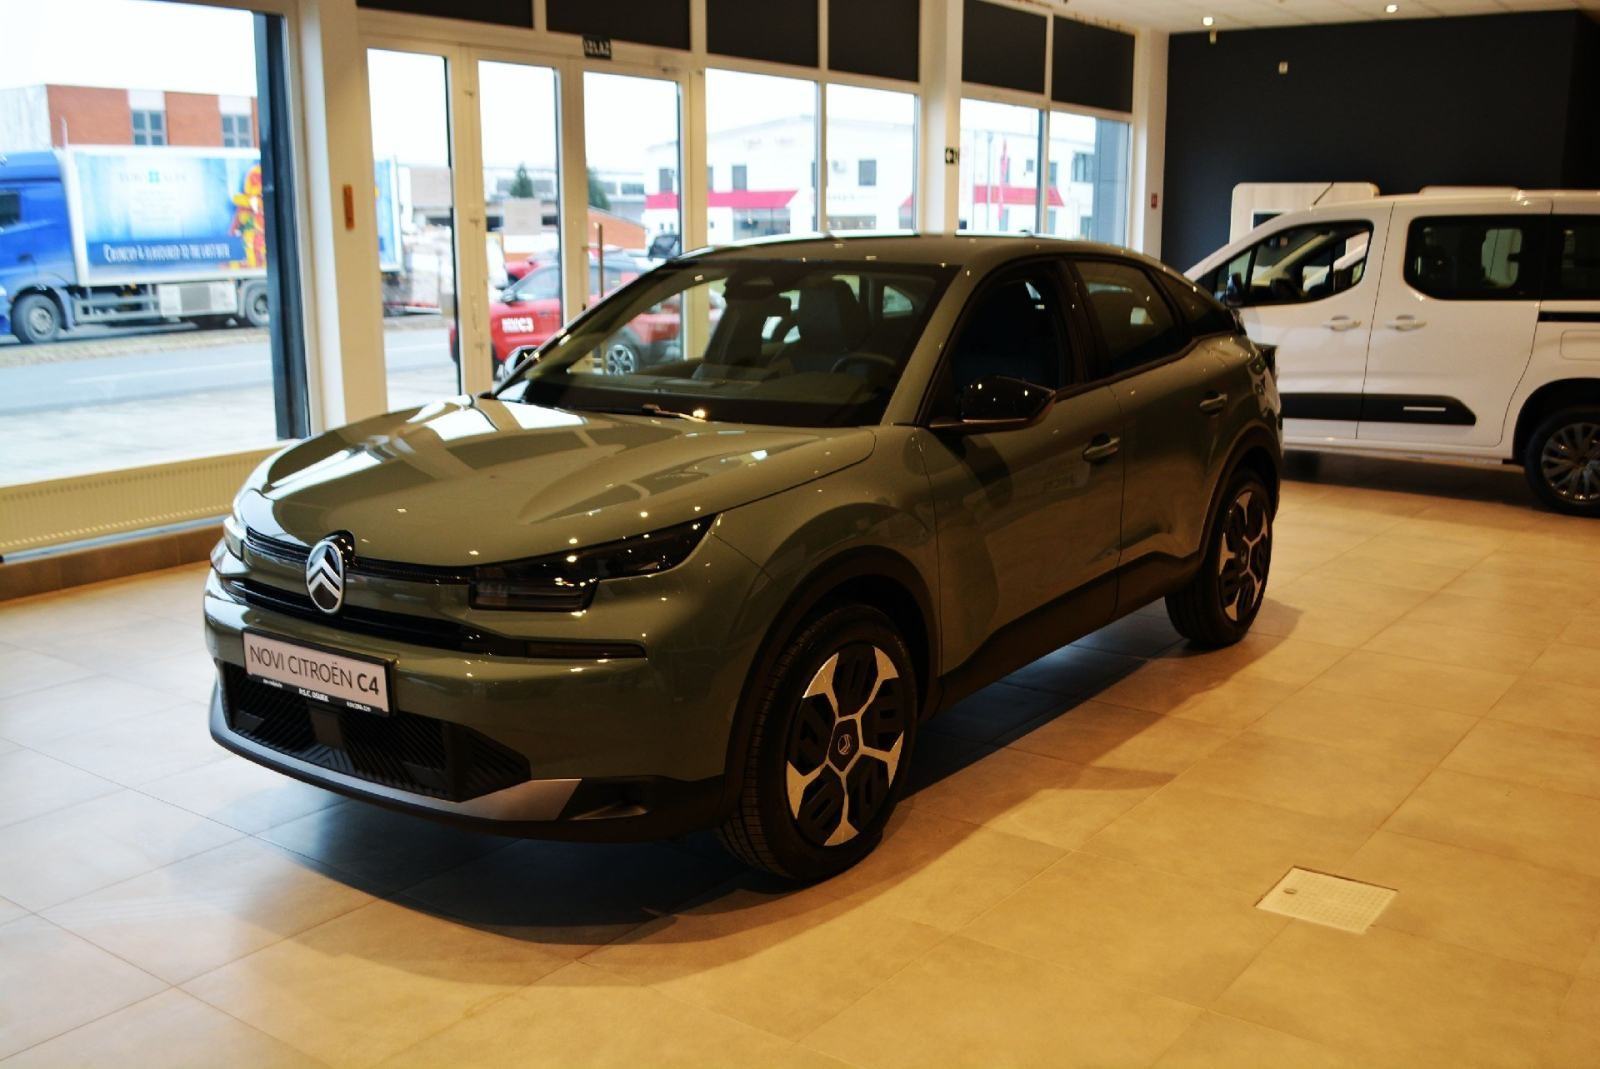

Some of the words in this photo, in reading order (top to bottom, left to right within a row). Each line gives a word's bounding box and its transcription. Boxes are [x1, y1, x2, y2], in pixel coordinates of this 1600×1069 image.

[250, 645, 284, 671] NOVI
[288, 655, 353, 688] CITROËN
[356, 673, 379, 695] C4
